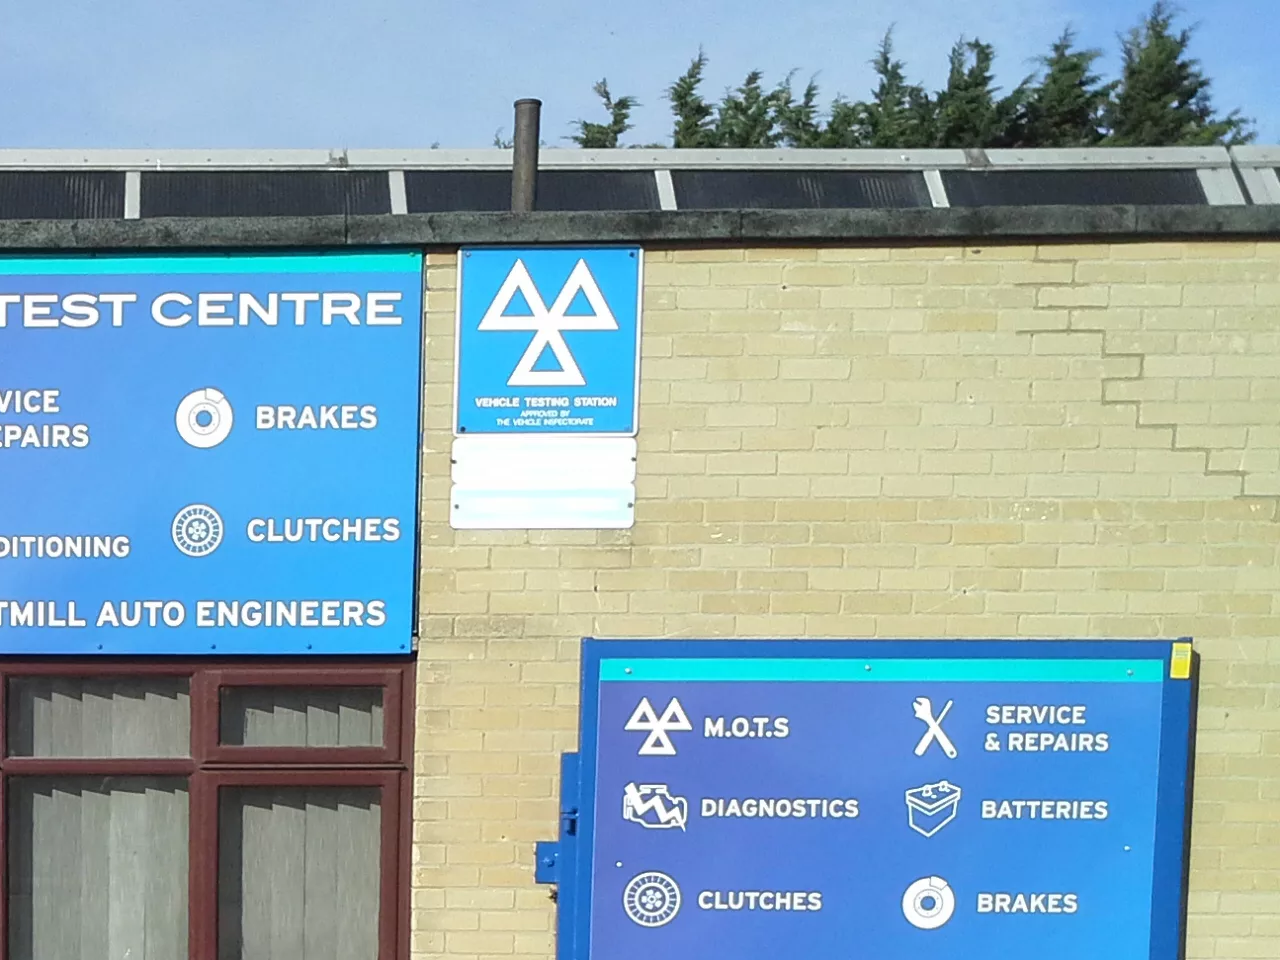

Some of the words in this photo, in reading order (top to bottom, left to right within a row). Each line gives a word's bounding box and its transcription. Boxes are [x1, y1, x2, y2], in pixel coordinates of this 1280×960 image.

[150, 292, 404, 327] CENTRE
[475, 397, 520, 407] VEHICLE
[524, 397, 570, 407] TESTING
[574, 397, 617, 407] STATION
[255, 405, 378, 430] BRAKES
[496, 418, 510, 426] THE
[246, 518, 401, 543] CLUTCHES
[96, 601, 186, 627] AUTO
[196, 600, 387, 627] ENGINEERS
[985, 705, 1086, 725] SERVICE
[703, 716, 790, 738] M.O.T.S
[984, 733, 1001, 751] &
[1007, 733, 1109, 752] REPAIRS
[700, 797, 860, 819] DIAGNOSTICS
[980, 799, 1109, 821] BATTERIES
[698, 890, 823, 912] CLUTCHES
[976, 892, 1078, 913] BRAKES
